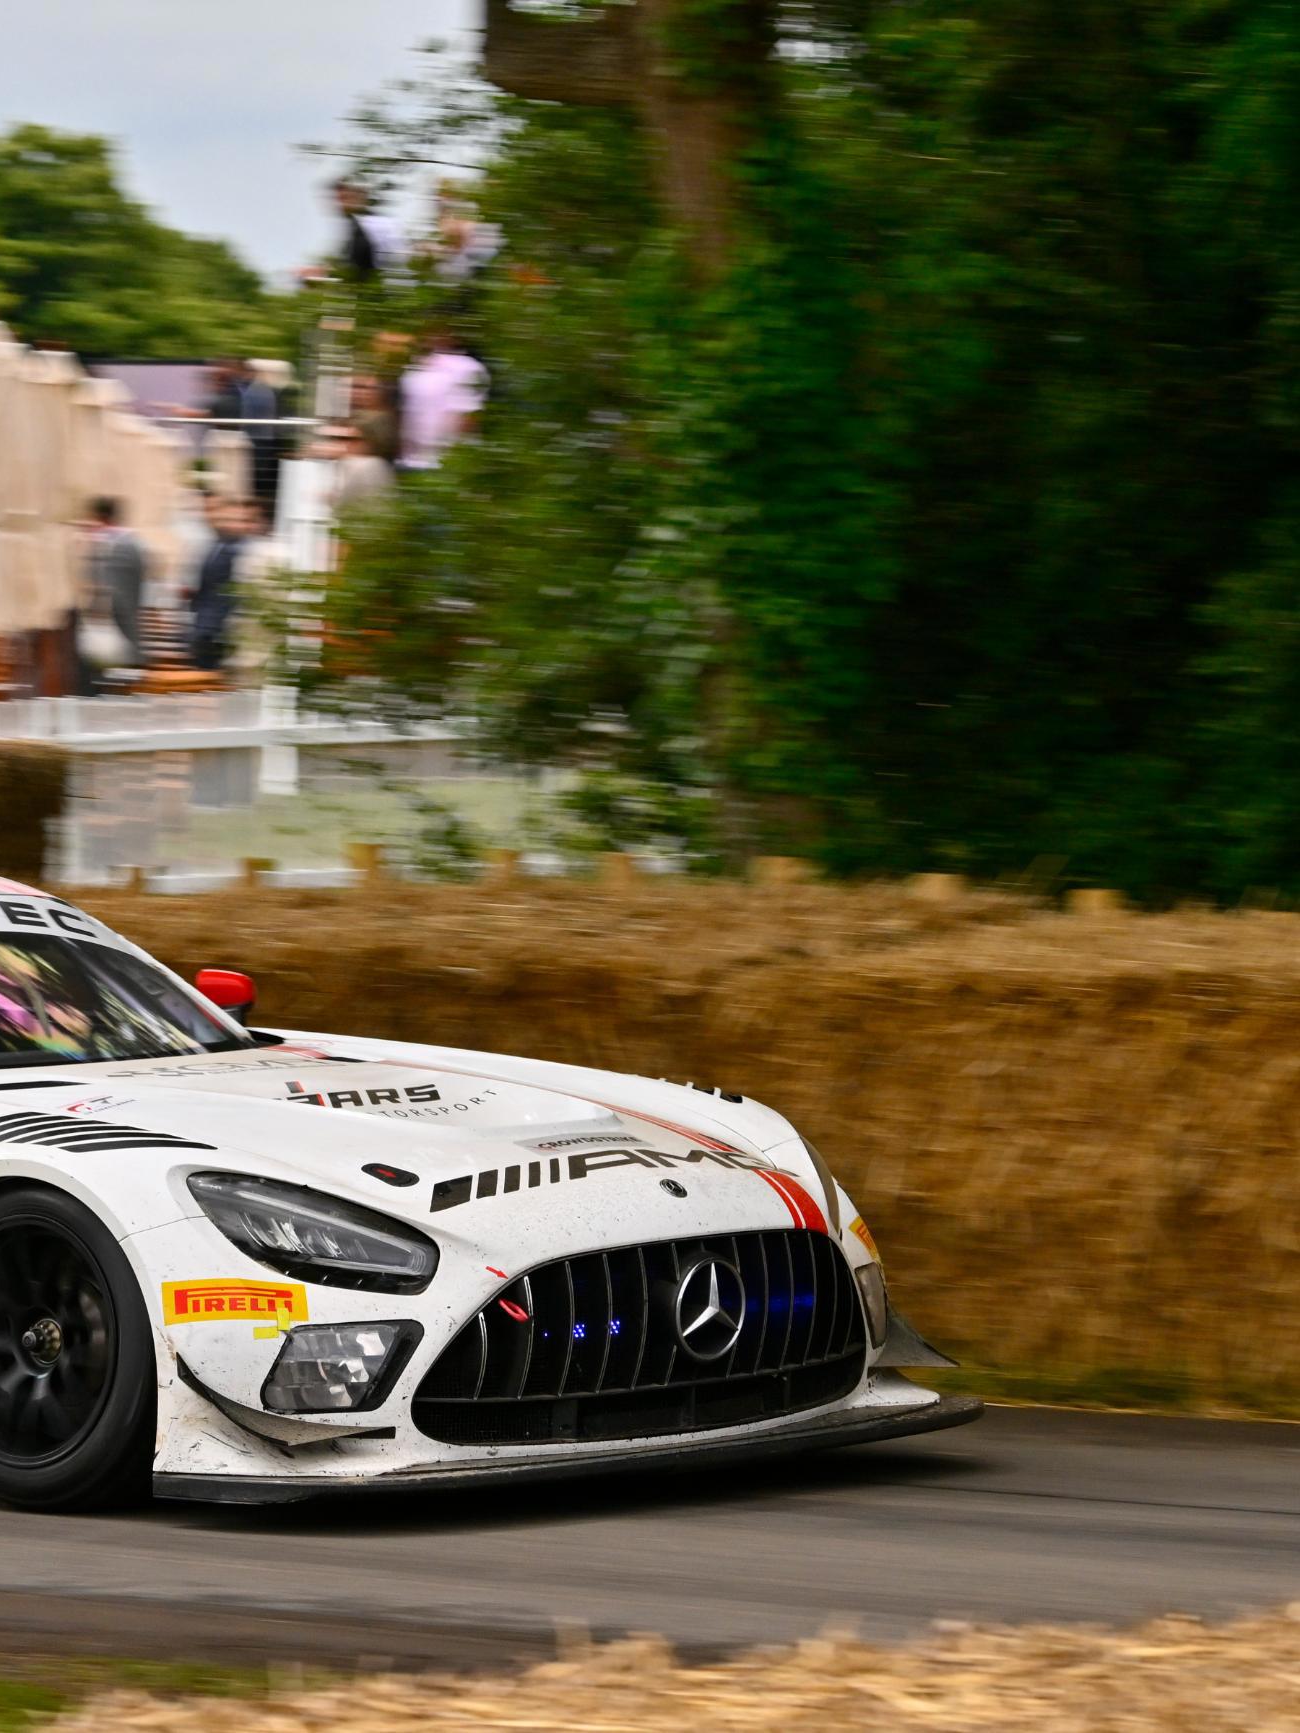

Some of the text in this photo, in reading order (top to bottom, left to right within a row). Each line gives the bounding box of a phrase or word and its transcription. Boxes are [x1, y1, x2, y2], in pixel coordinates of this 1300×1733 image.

[368, 1088, 499, 1119] TORSPORT
[536, 1136, 643, 1149] CROWDSTRIKE
[568, 1149, 801, 1180] AMG
[174, 1286, 293, 1315] PIRELLI
